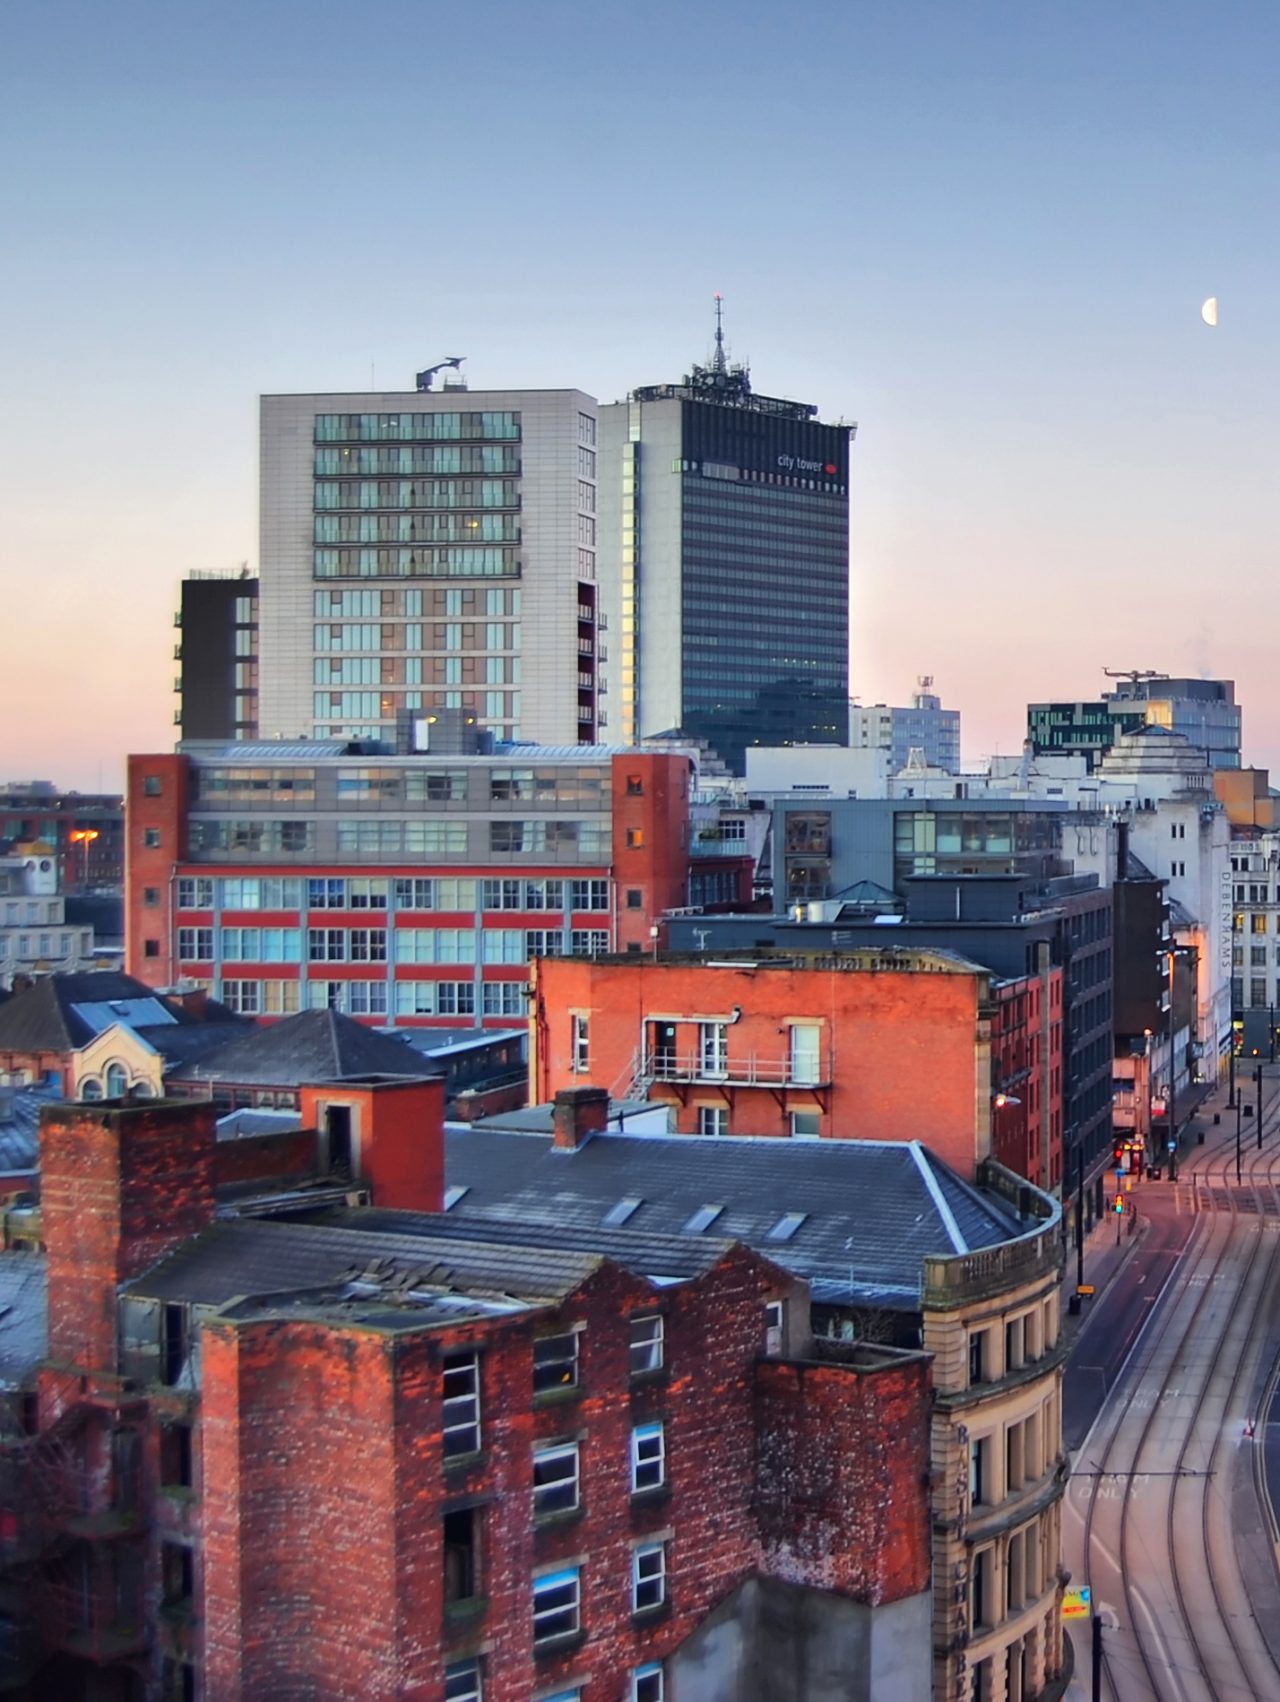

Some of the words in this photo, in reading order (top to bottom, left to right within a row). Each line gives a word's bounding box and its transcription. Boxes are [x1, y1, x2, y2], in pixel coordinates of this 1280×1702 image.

[777, 454, 795, 471] city
[796, 457, 823, 473] tower
[1078, 1487, 1144, 1499] ONLY
